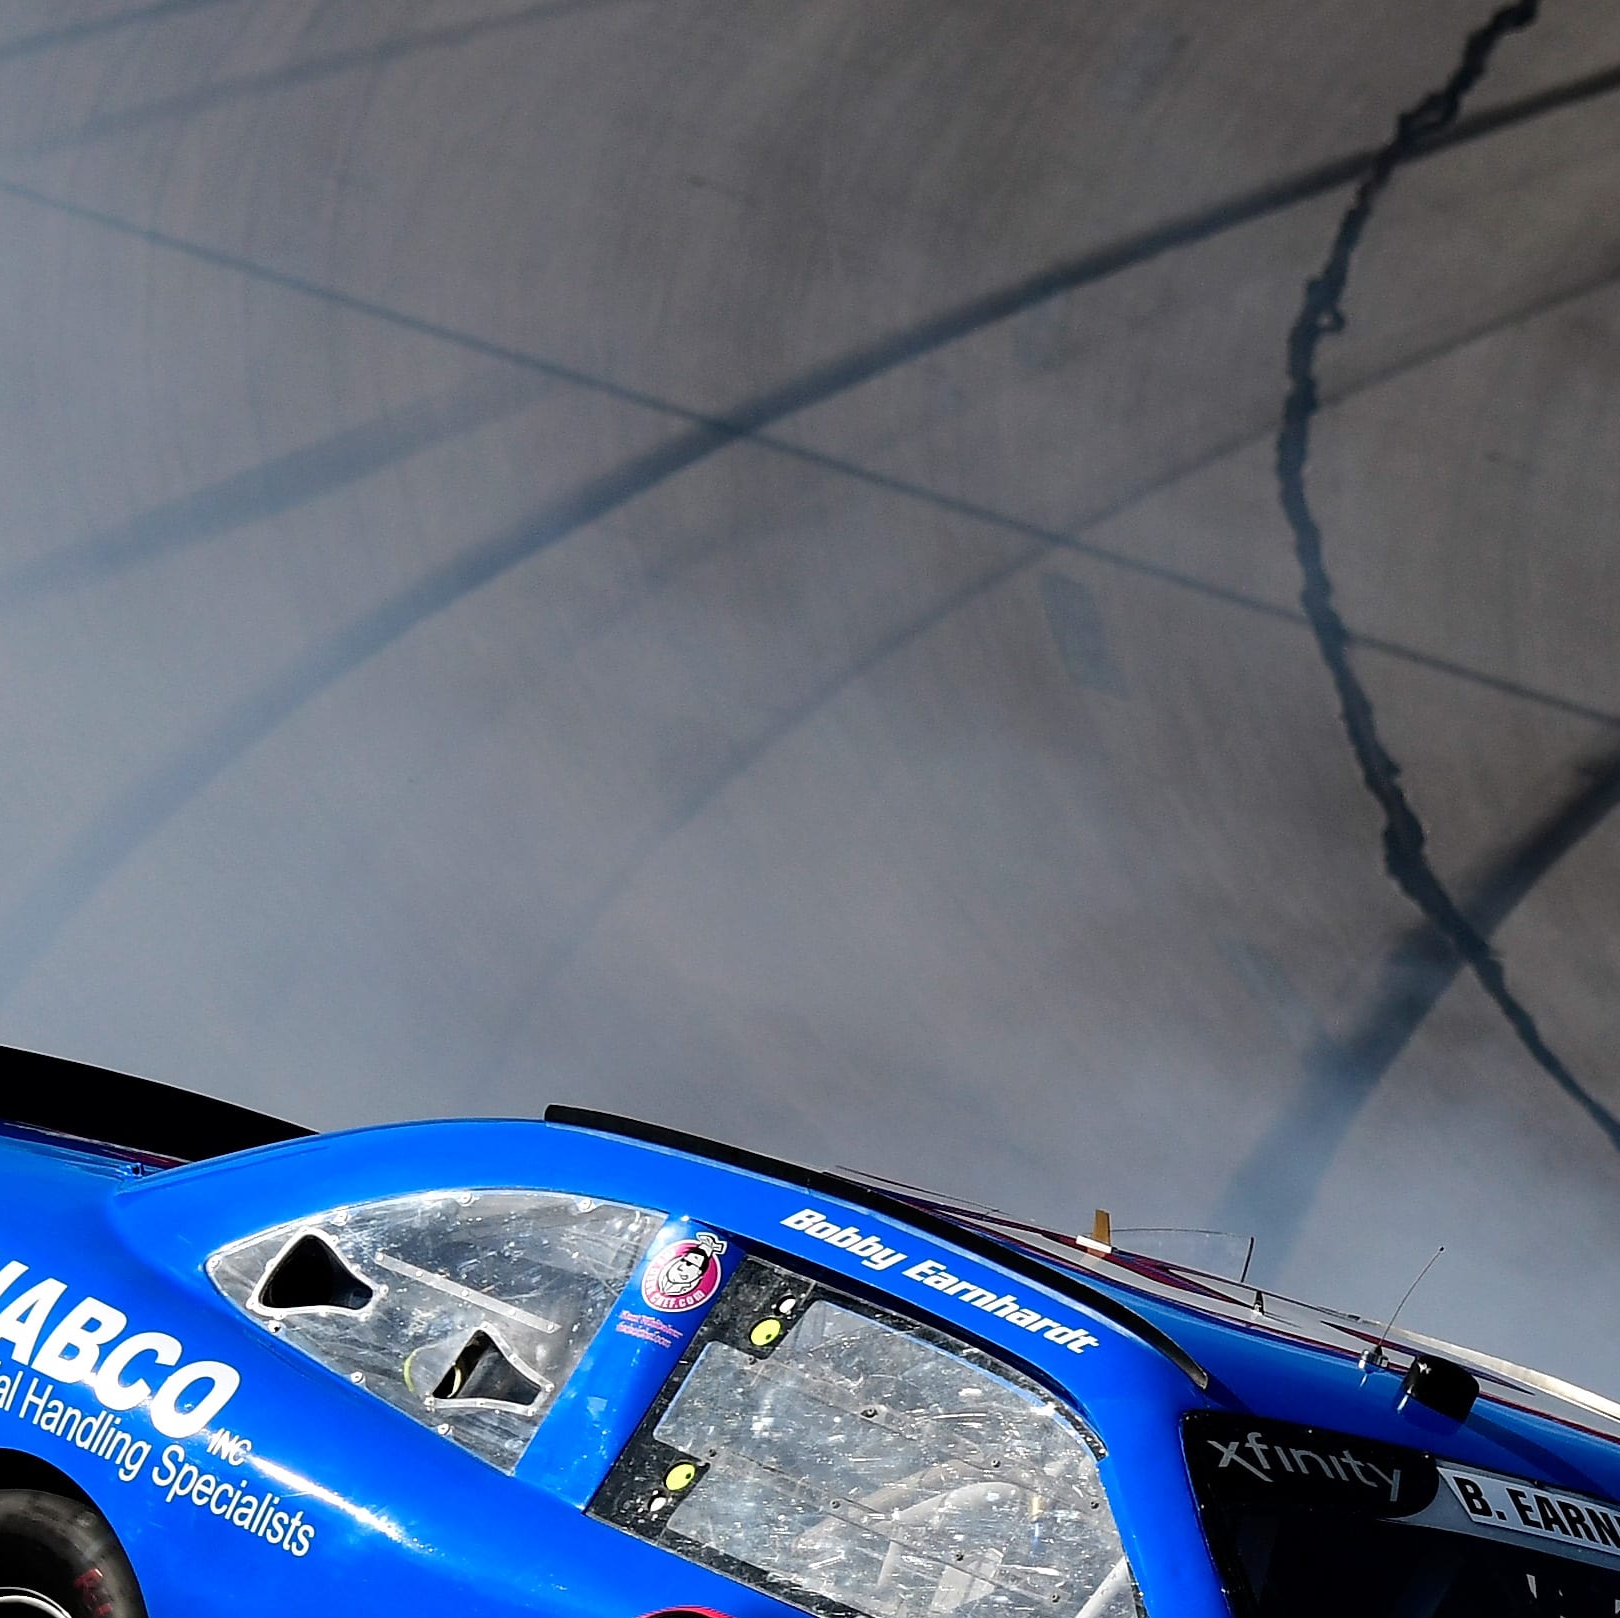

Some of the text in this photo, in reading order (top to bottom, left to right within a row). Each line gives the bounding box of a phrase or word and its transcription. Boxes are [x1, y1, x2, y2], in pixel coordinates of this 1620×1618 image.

[781, 1208, 1100, 1354] Bobby Earnhardt
[20, 1377, 151, 1481] Handling
[152, 1443, 315, 1558] Specialists
[207, 1428, 252, 1466] INC
[1206, 1431, 1403, 1502] xfinity
[1452, 1477, 1506, 1523] B.
